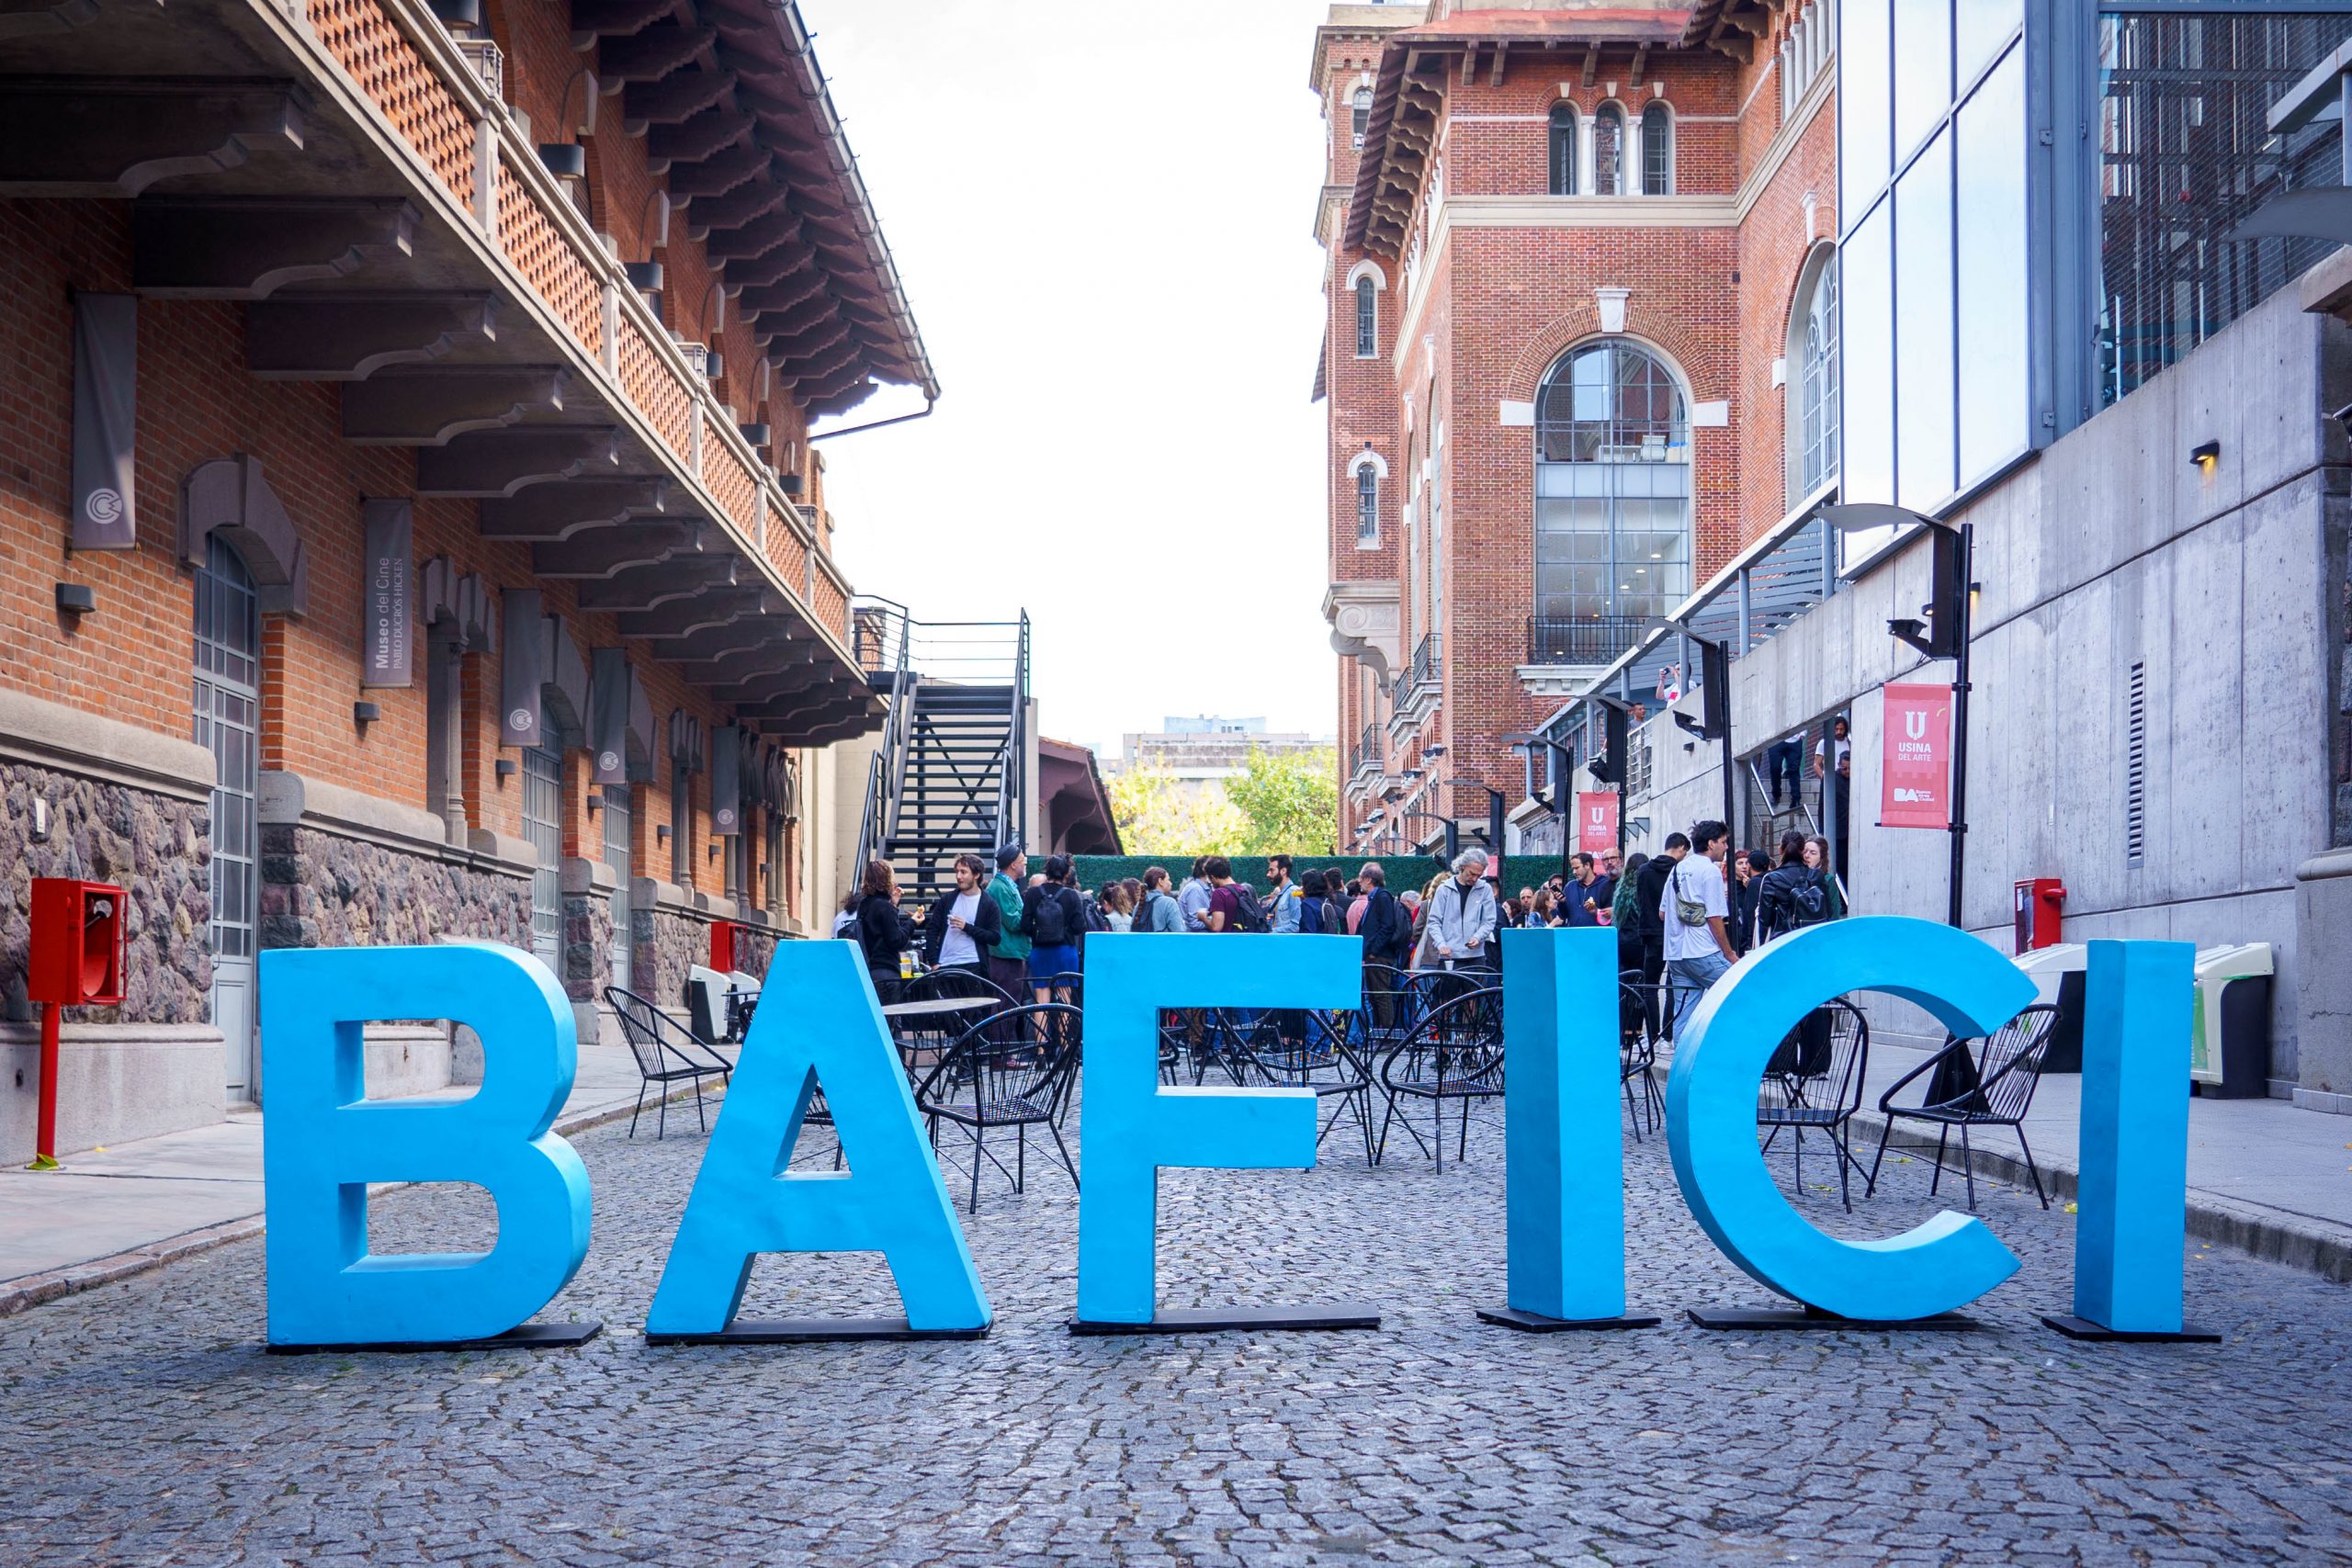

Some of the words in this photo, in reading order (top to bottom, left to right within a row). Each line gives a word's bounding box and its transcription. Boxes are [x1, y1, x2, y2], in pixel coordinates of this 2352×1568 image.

[376, 558, 390, 589] Cine
[393, 558, 402, 596] HICKEN
[376, 592, 390, 614] del
[392, 599, 402, 638] DUCRÓS
[375, 617, 389, 669] Museo
[393, 640, 402, 670] PABLO
[1905, 711, 1927, 740] U
[1898, 742, 1931, 753] USINA
[1898, 753, 1911, 761] DEL
[1913, 753, 1931, 762] ARTE
[1894, 787, 1918, 802] BA
[261, 915, 2196, 1348] BAFICI
